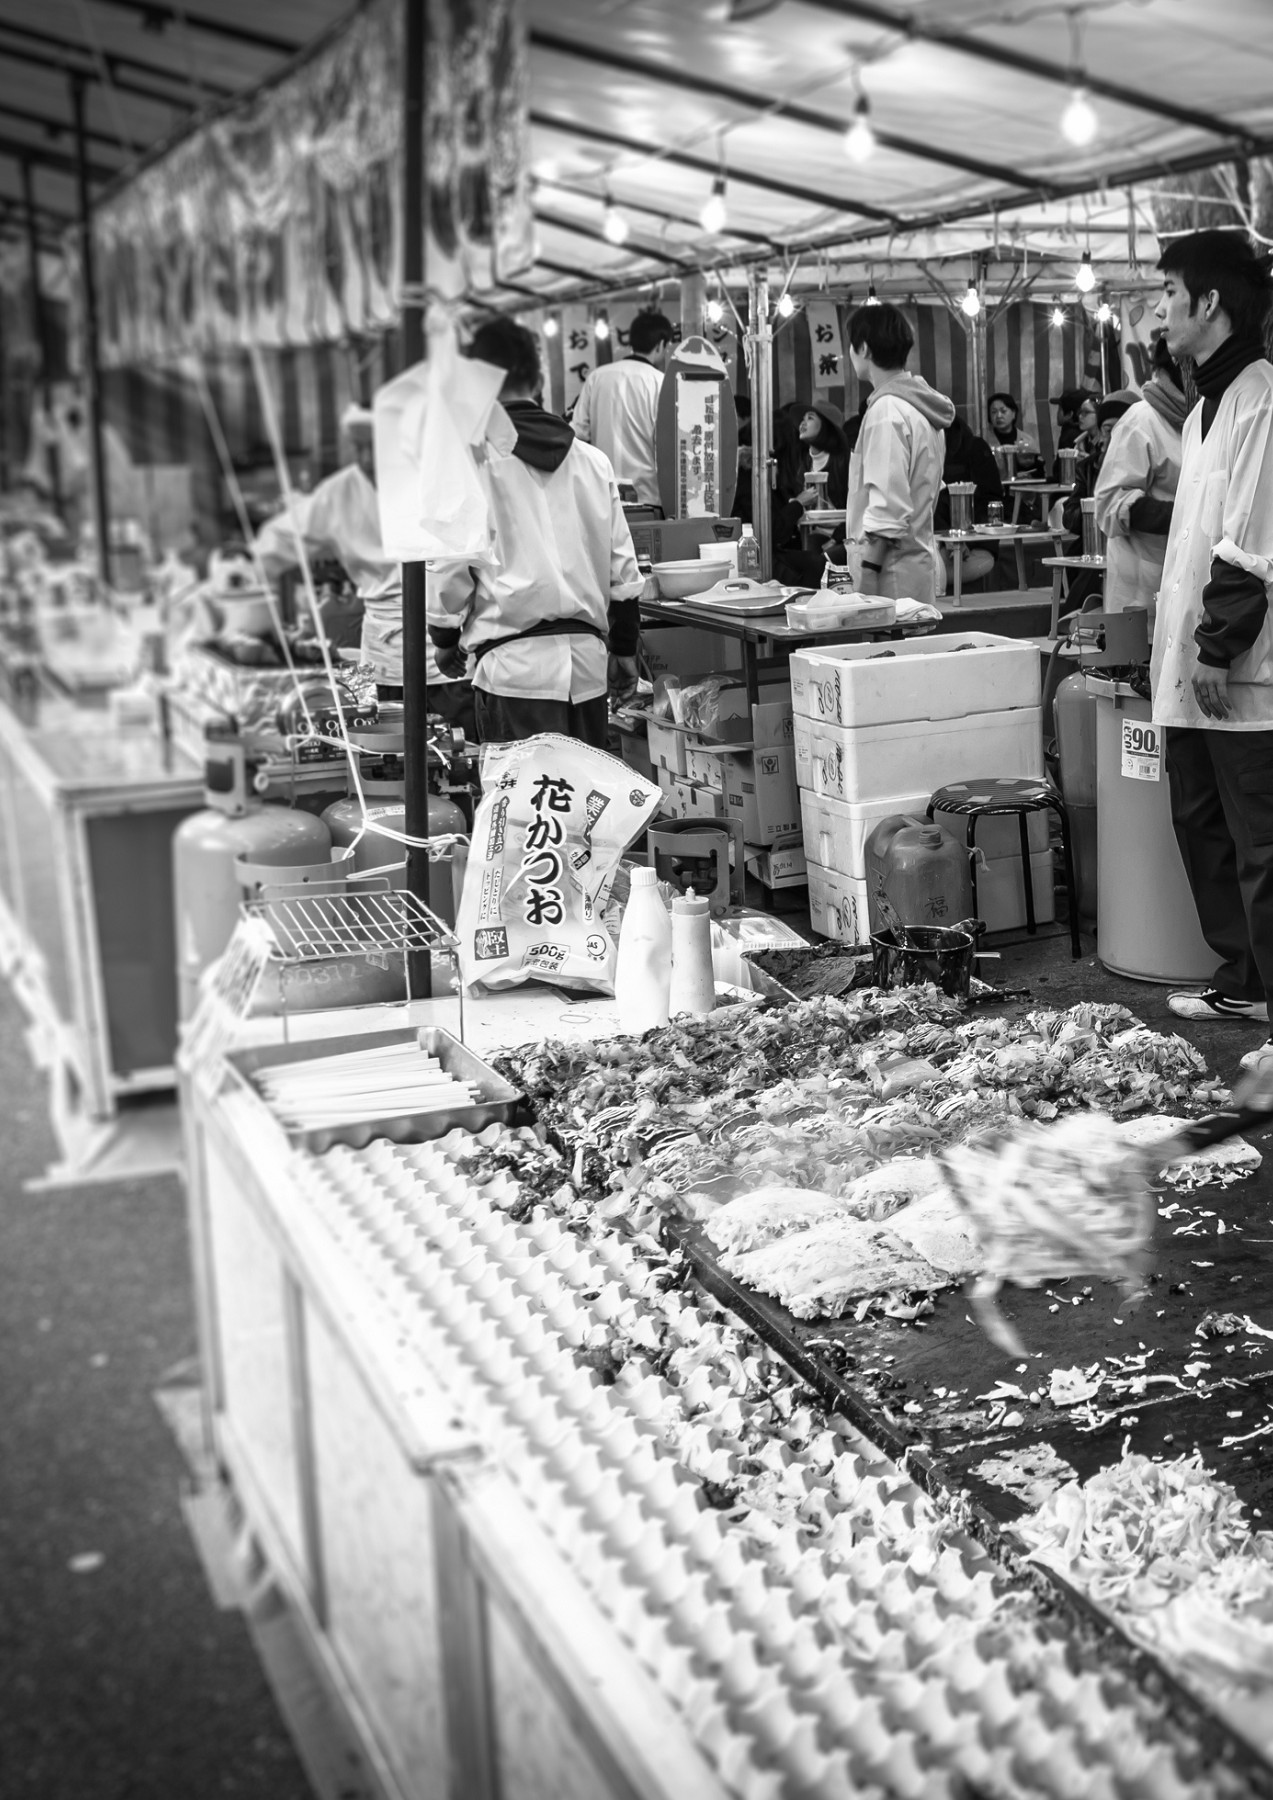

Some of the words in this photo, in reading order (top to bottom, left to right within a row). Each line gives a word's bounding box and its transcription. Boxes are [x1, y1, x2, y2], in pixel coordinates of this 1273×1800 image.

[524, 773, 575, 925] 花かつお
[528, 944, 567, 961] 500g
